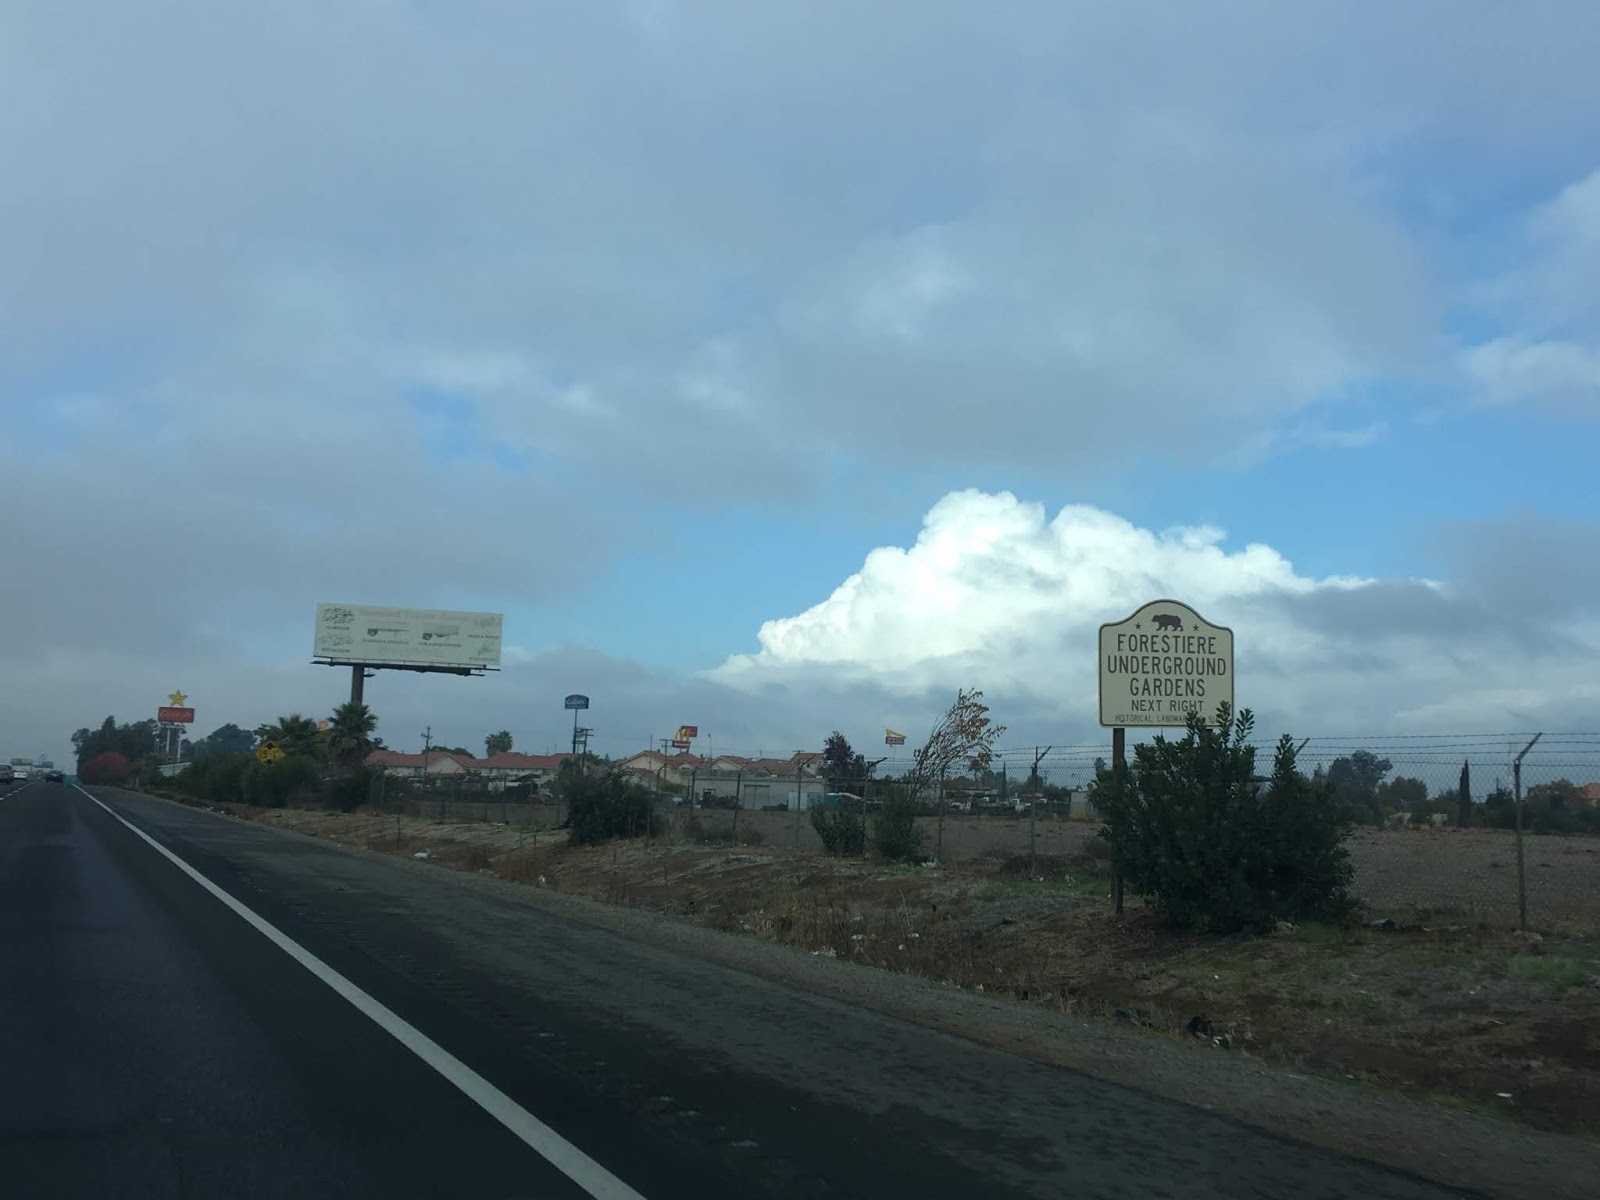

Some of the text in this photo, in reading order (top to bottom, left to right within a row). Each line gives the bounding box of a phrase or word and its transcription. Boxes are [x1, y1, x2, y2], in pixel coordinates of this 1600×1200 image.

[1117, 633, 1217, 655] FORESTIERE
[1107, 654, 1226, 676] UNDERGROUND
[1130, 677, 1205, 697] GARDENS
[1131, 699, 1204, 712] NEXT RIGHT
[1115, 714, 1153, 723] HISTORICAL
[1157, 714, 1190, 723] LANDMAR
